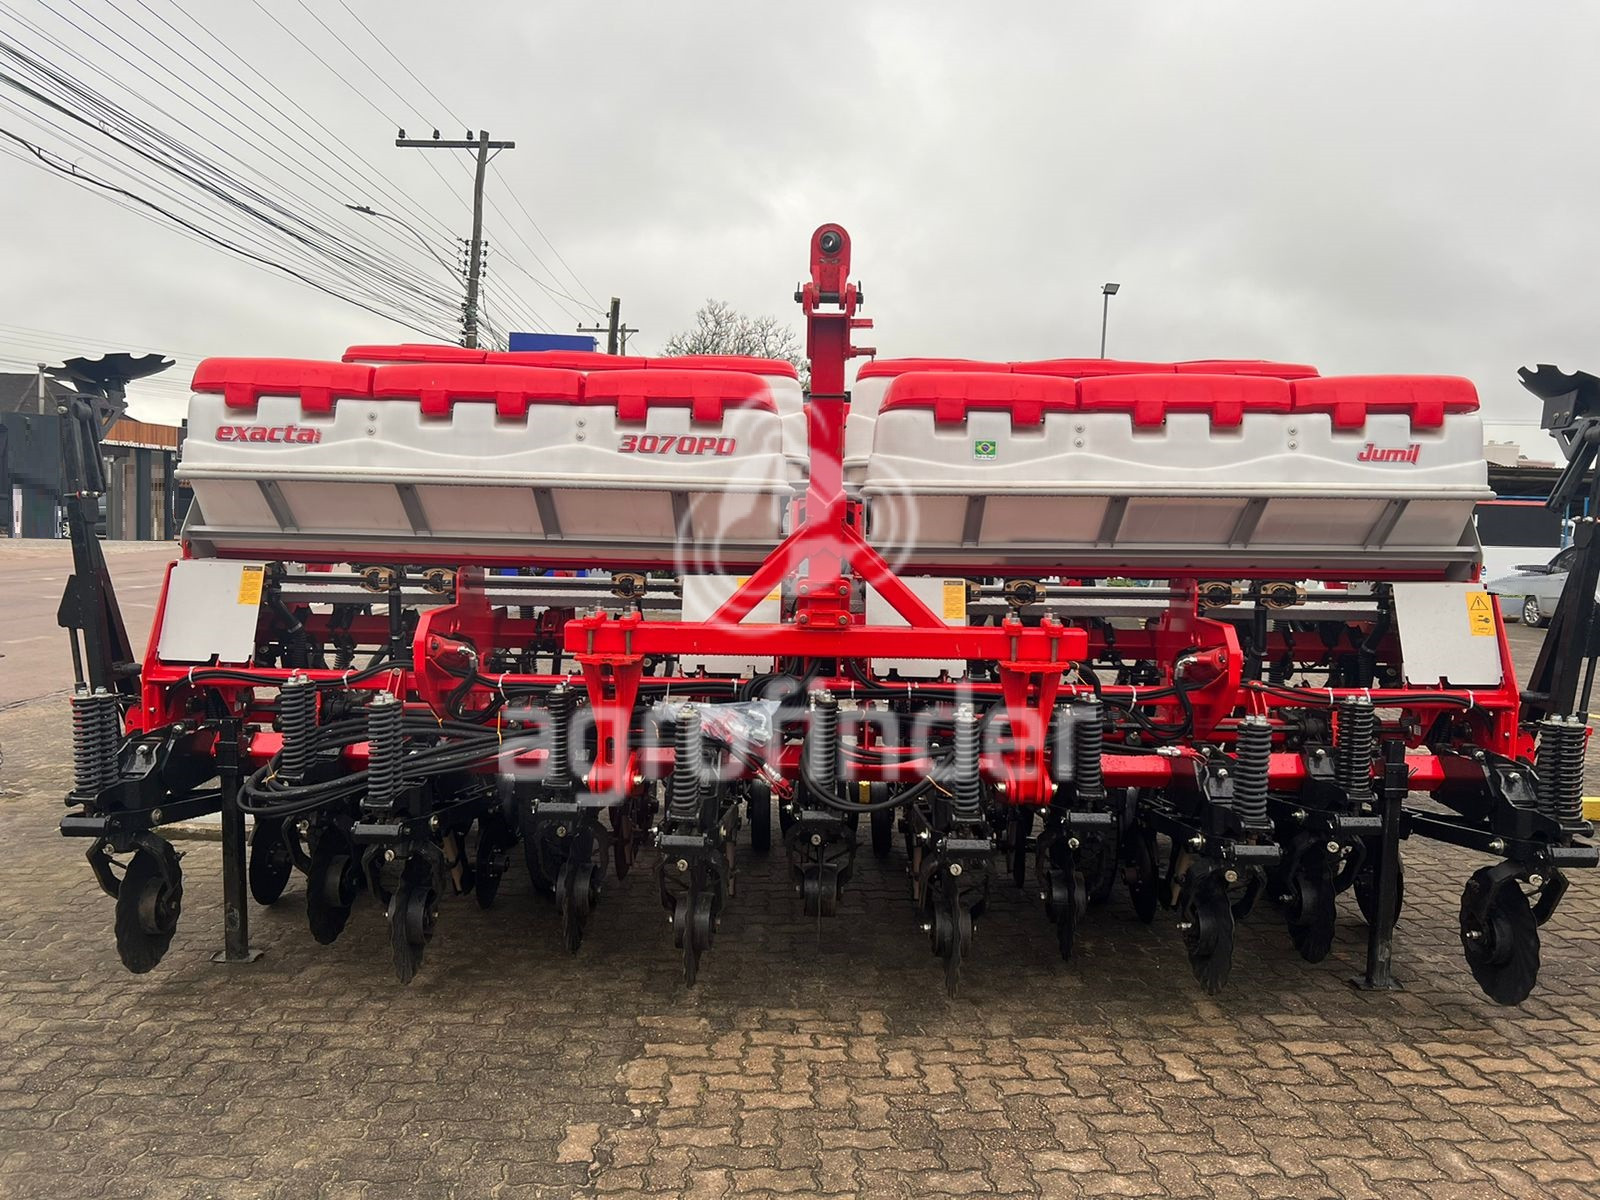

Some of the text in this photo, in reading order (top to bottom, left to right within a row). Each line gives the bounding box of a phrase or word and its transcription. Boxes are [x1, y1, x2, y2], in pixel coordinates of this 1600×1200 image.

[215, 425, 316, 444] exacta
[618, 434, 736, 456] 3070PD
[1357, 442, 1421, 465] Jumil
